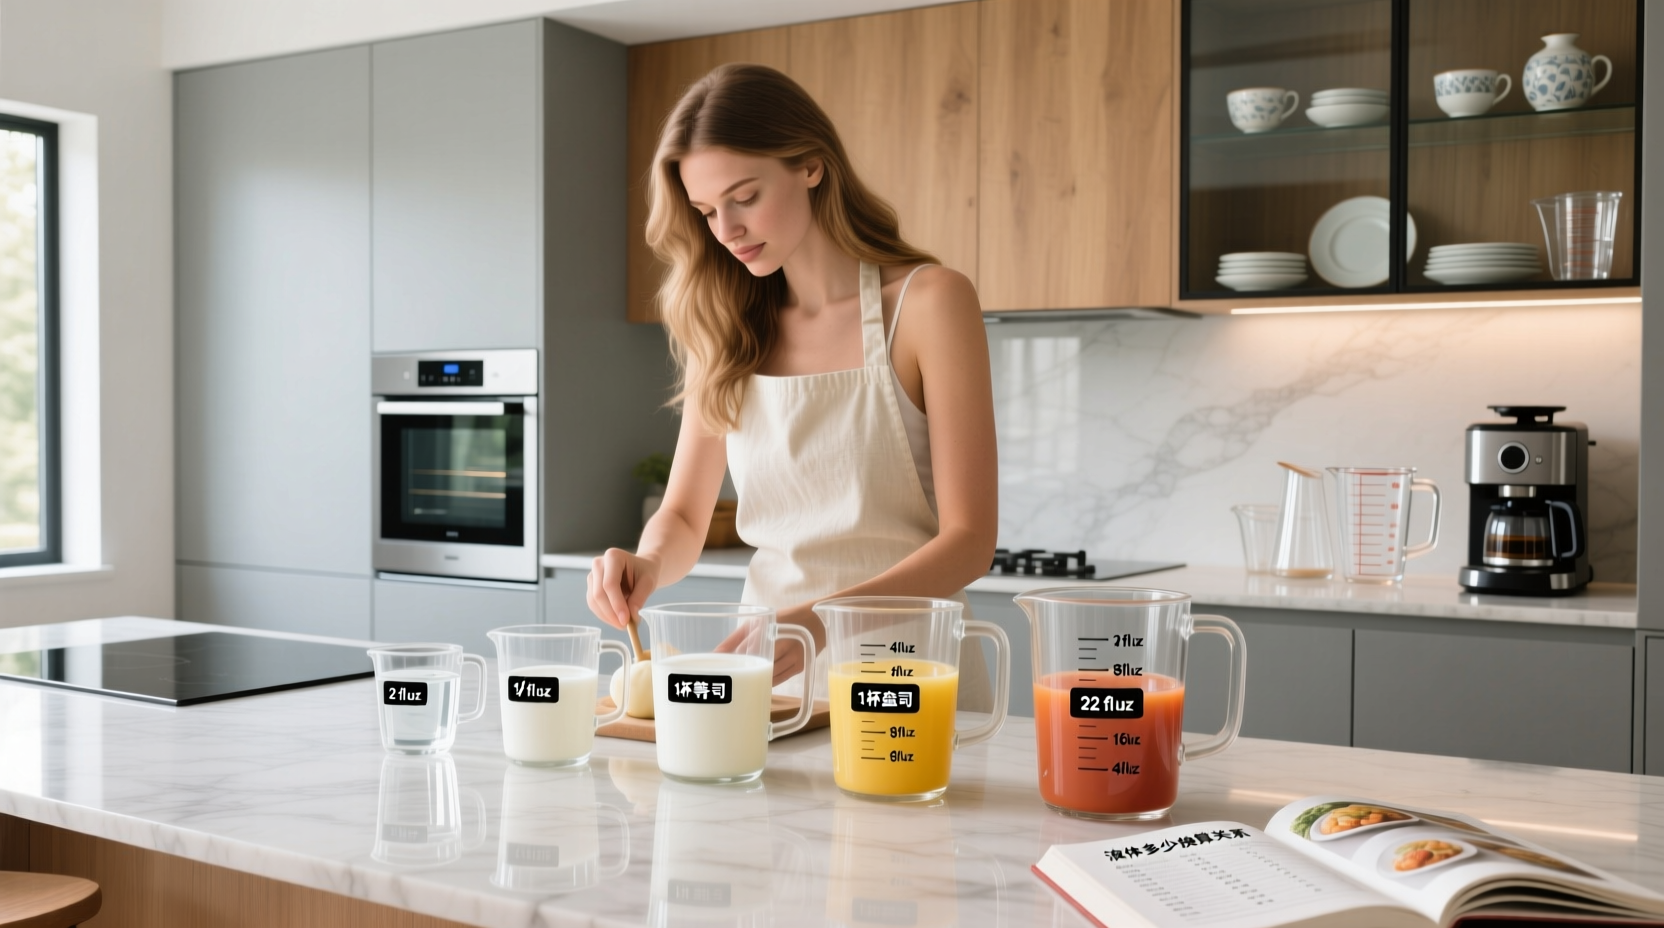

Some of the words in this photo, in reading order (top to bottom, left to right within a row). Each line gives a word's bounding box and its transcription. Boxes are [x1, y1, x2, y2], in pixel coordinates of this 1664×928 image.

[389, 687, 397, 700] 2
[1080, 695, 1100, 711] 22
[1103, 695, 1135, 712] fluz
